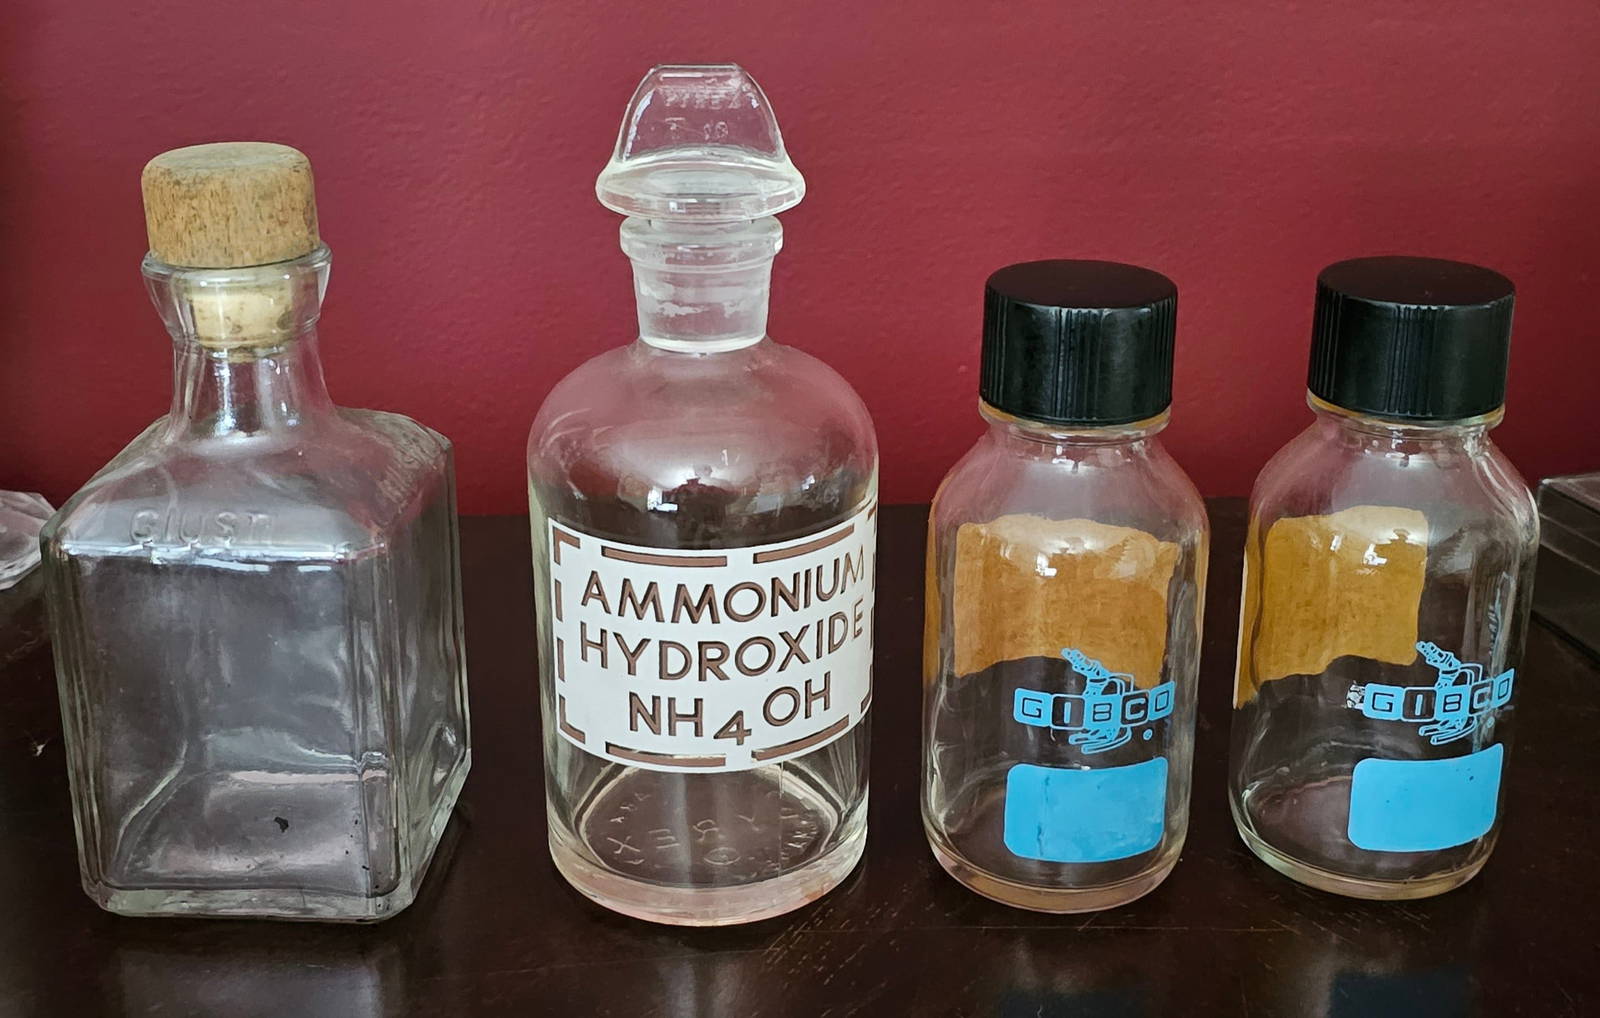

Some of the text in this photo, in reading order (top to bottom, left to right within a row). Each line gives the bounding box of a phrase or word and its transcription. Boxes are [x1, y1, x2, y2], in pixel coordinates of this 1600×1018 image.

[581, 545, 865, 624] AMMONIUM
[580, 598, 864, 682] HYDROXIDE
[1017, 686, 1172, 727] GIBCO
[1368, 674, 1511, 719] GIBCO
